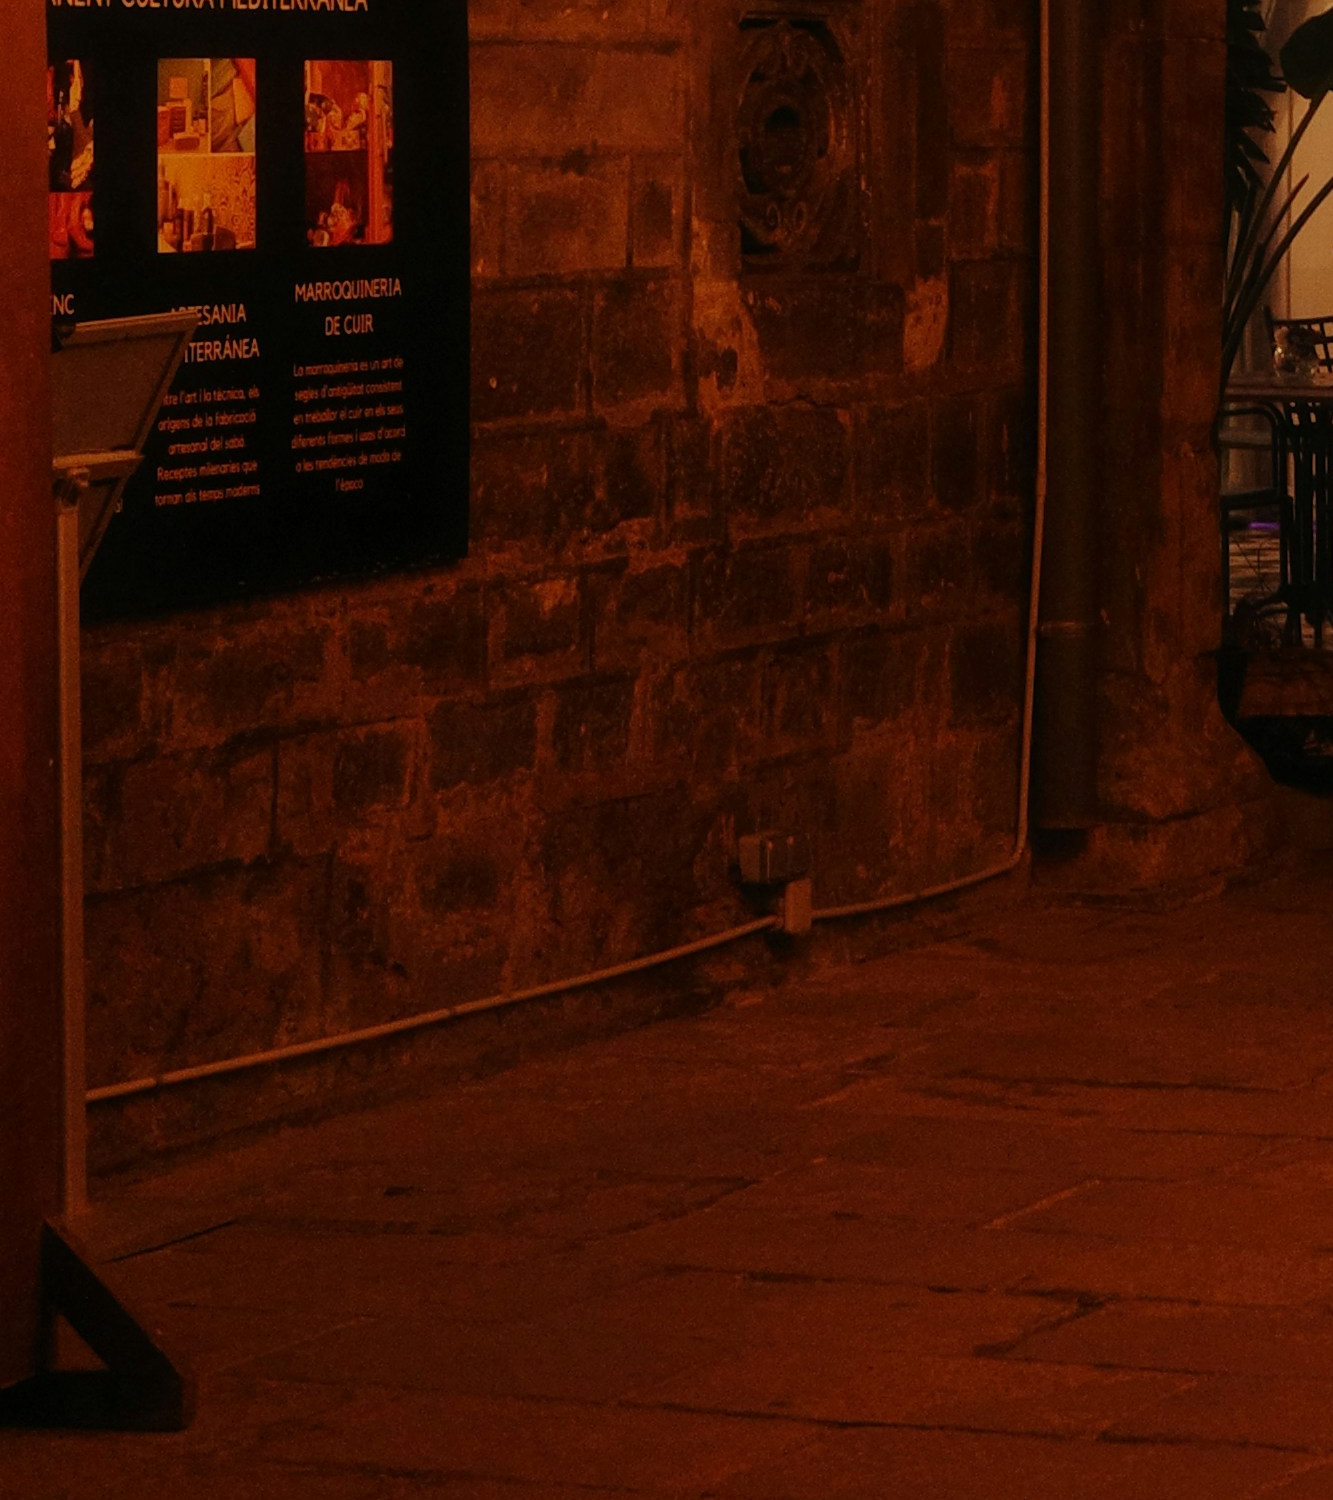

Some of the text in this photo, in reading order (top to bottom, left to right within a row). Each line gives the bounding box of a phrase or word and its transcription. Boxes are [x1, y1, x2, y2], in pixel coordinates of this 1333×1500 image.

[295, 277, 402, 303] MARROQUINERIA
[51, 293, 75, 316] NC
[171, 303, 247, 326] ESANIA
[325, 313, 374, 336] DE CUIR
[293, 362, 304, 377] La
[369, 359, 379, 370] un
[380, 357, 392, 369] art
[203, 387, 211, 402] la
[248, 384, 260, 399] els
[191, 413, 203, 428] de
[205, 412, 213, 427] la
[293, 414, 303, 425] en
[209, 435, 223, 451] del
[157, 466, 198, 482] Receptes
[241, 460, 258, 475] que
